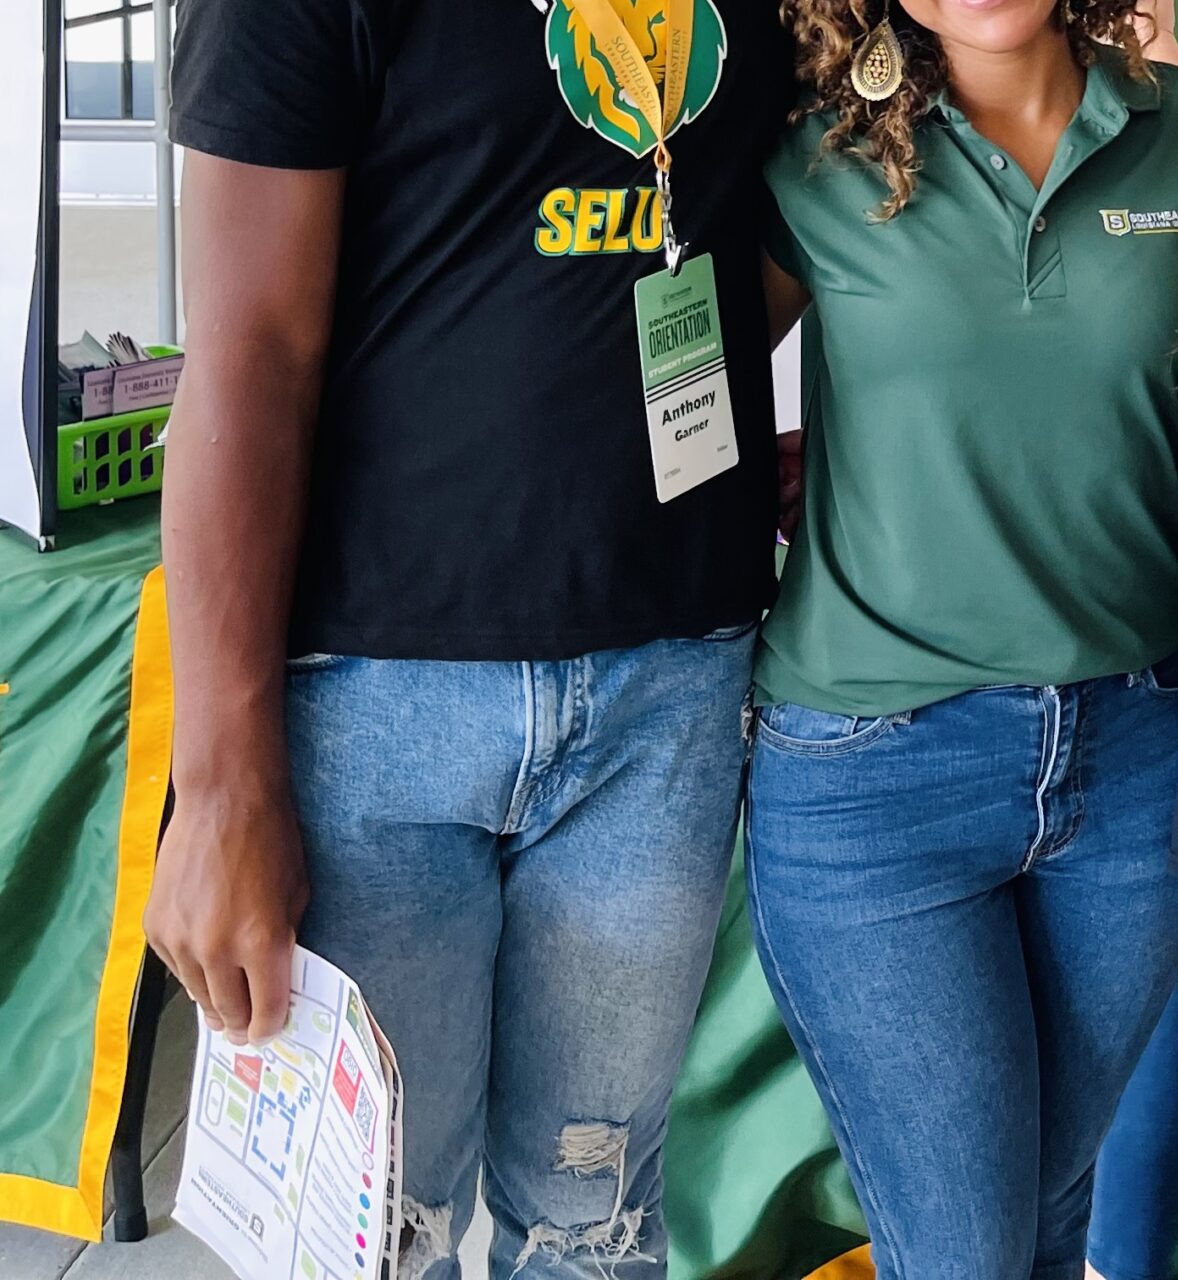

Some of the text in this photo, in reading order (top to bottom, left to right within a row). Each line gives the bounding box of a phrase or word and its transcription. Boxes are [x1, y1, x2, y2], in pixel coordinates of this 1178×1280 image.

[535, 187, 666, 256] SELU
[648, 298, 708, 330] SOUTHEASTERN
[649, 307, 712, 359] ORIENTATION
[662, 390, 716, 427] Anthony
[675, 419, 710, 442] Garner
